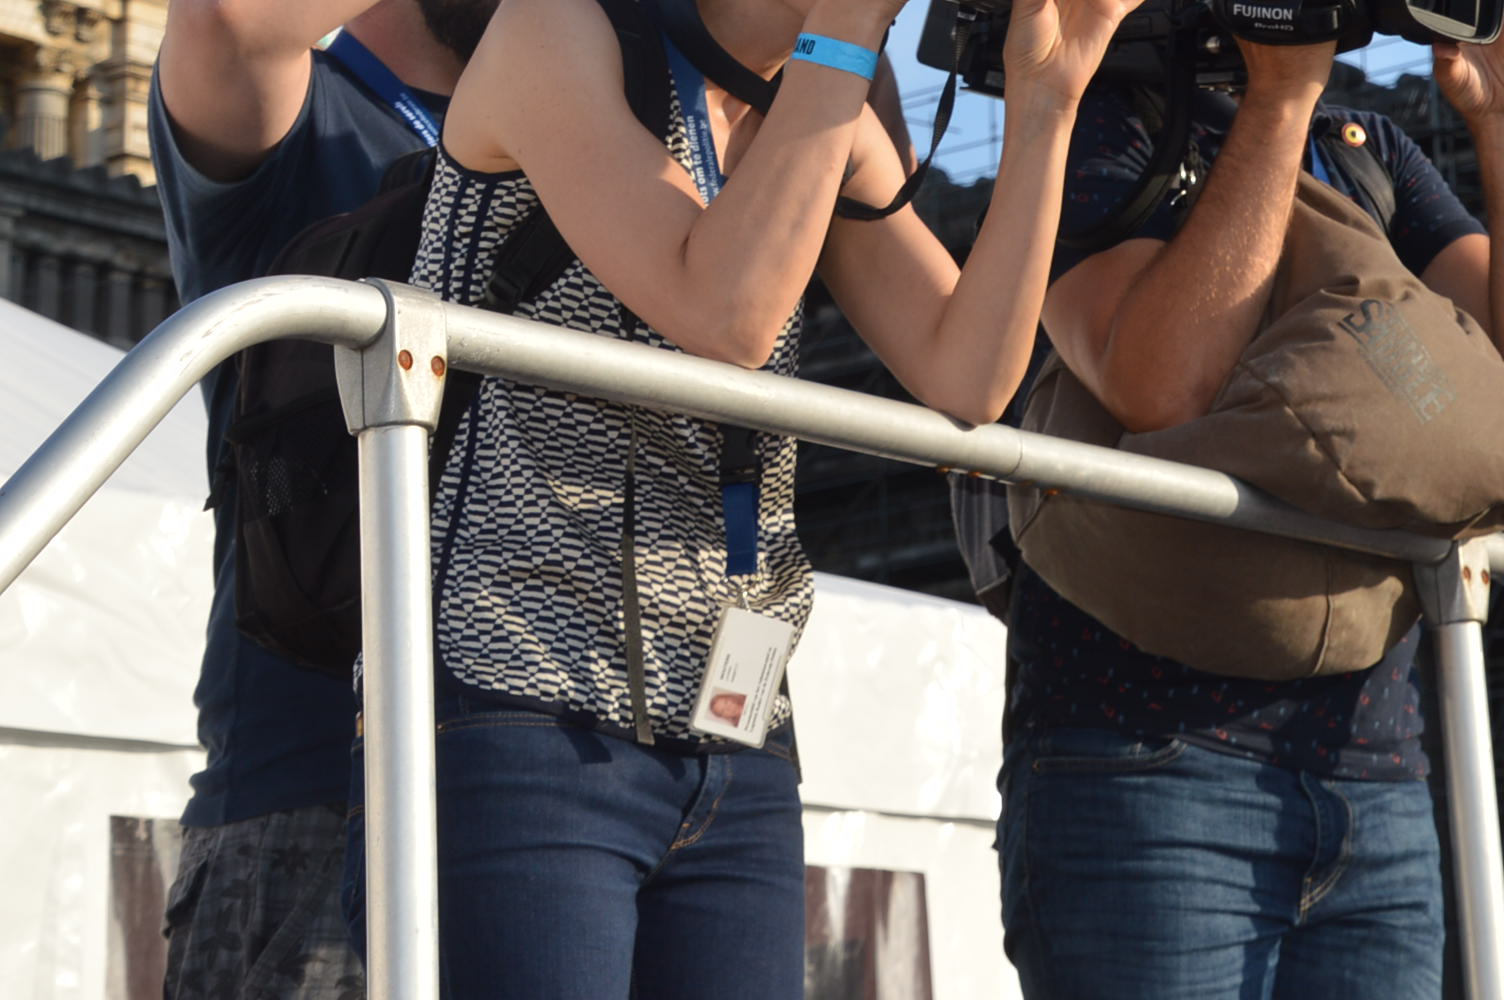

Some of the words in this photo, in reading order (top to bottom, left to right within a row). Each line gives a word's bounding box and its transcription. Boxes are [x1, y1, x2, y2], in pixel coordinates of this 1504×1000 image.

[1233, 3, 1293, 21] FUJINON
[687, 115, 700, 152] dienen
[693, 153, 702, 165] te
[696, 167, 706, 185] om
